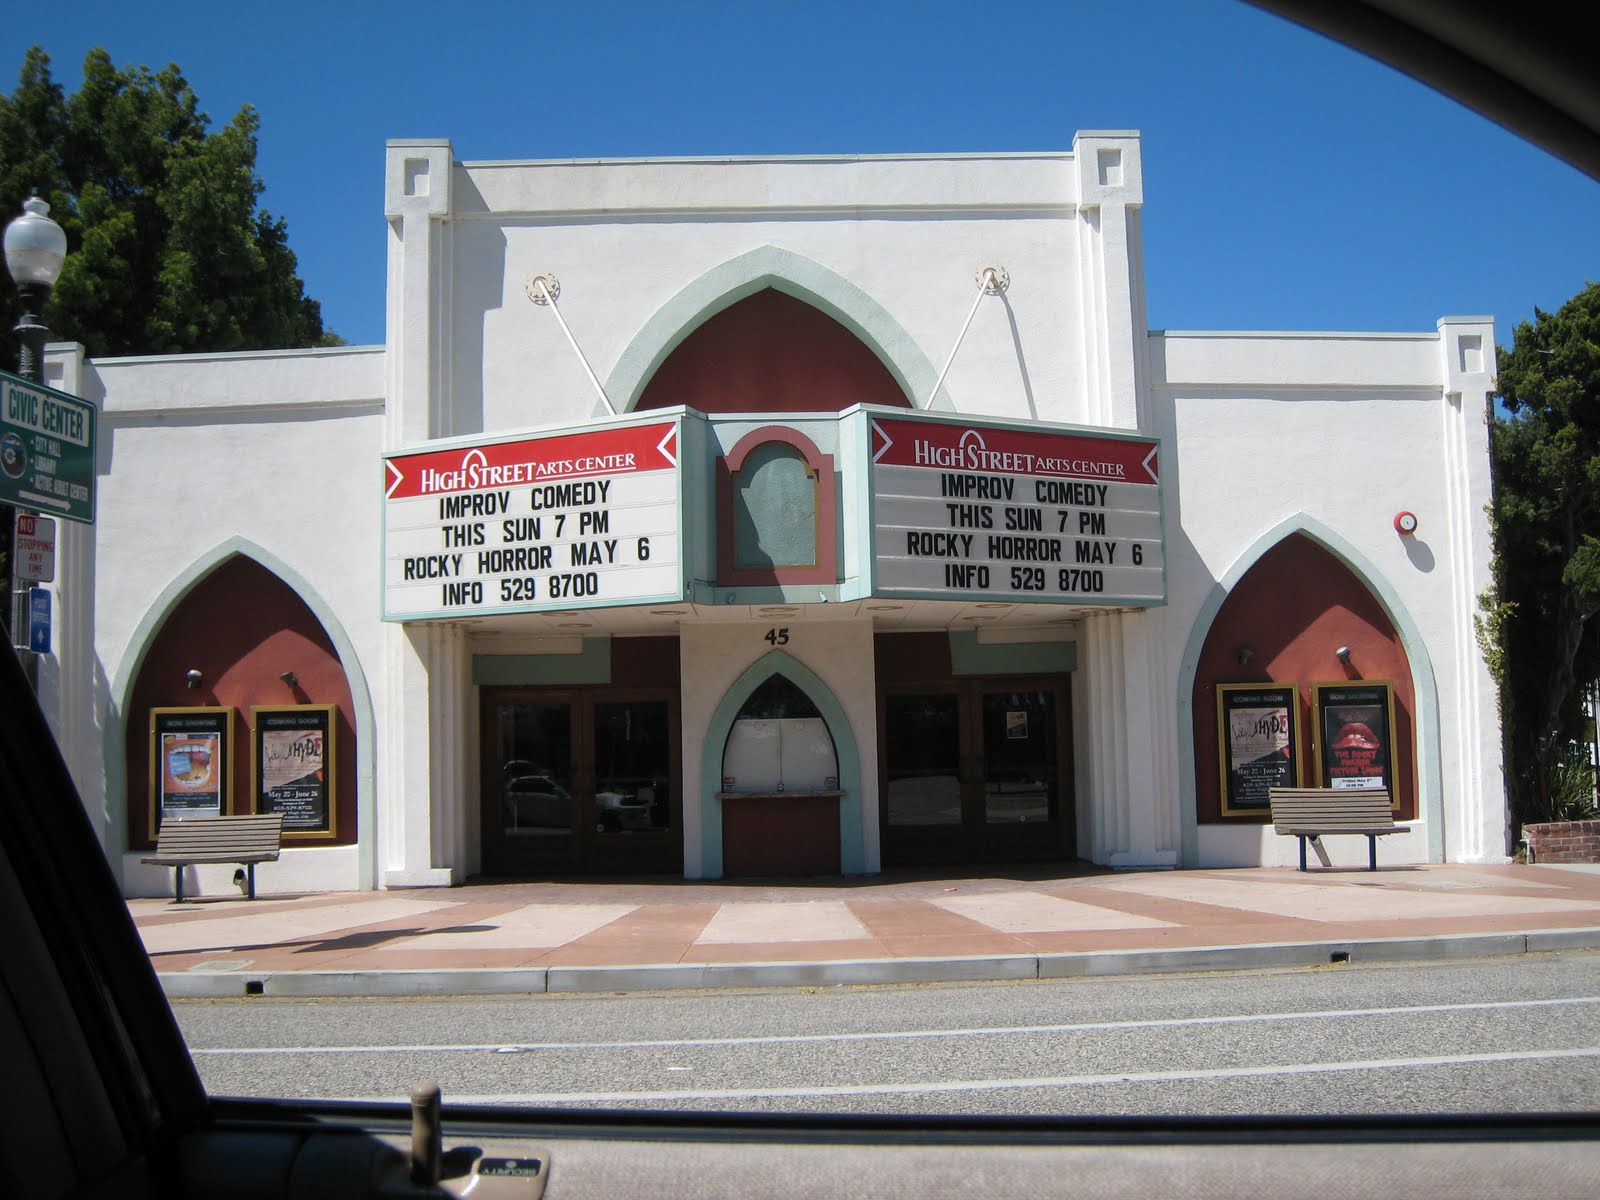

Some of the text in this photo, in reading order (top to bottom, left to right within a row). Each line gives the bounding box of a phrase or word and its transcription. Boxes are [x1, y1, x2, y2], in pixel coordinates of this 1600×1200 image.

[9, 388, 83, 441] CIVIC CENTER
[914, 439, 1125, 476] HIGH STREET ARTS CENTER
[420, 453, 636, 493] HIGH STREET ARTS CENTER
[440, 480, 611, 520] IMPROV COMEDY
[942, 473, 1108, 507] IMPROV COMEDY
[20, 518, 34, 534] NO
[442, 511, 609, 548] THIS SUN 7 PM
[946, 503, 1105, 535] THIS SUN 7 PM
[18, 537, 54, 553] STOPPING
[28, 552, 43, 563] ANY
[404, 537, 650, 580] ROCKY HORROR MAY 6
[907, 532, 1143, 566] ROCKY HORROR MAY 6
[28, 563, 43, 575] TIME
[945, 564, 1103, 593] INFO 529 8700
[442, 572, 598, 606] INFO 529 8700
[764, 628, 790, 645] 45
[1258, 714, 1288, 740] HYDE
[292, 737, 323, 763] HYDE
[1236, 768, 1249, 776] May
[1263, 767, 1277, 775] June
[1278, 766, 1286, 774] 26
[295, 790, 310, 799] June
[482, 1168, 537, 1176] SECURITY
